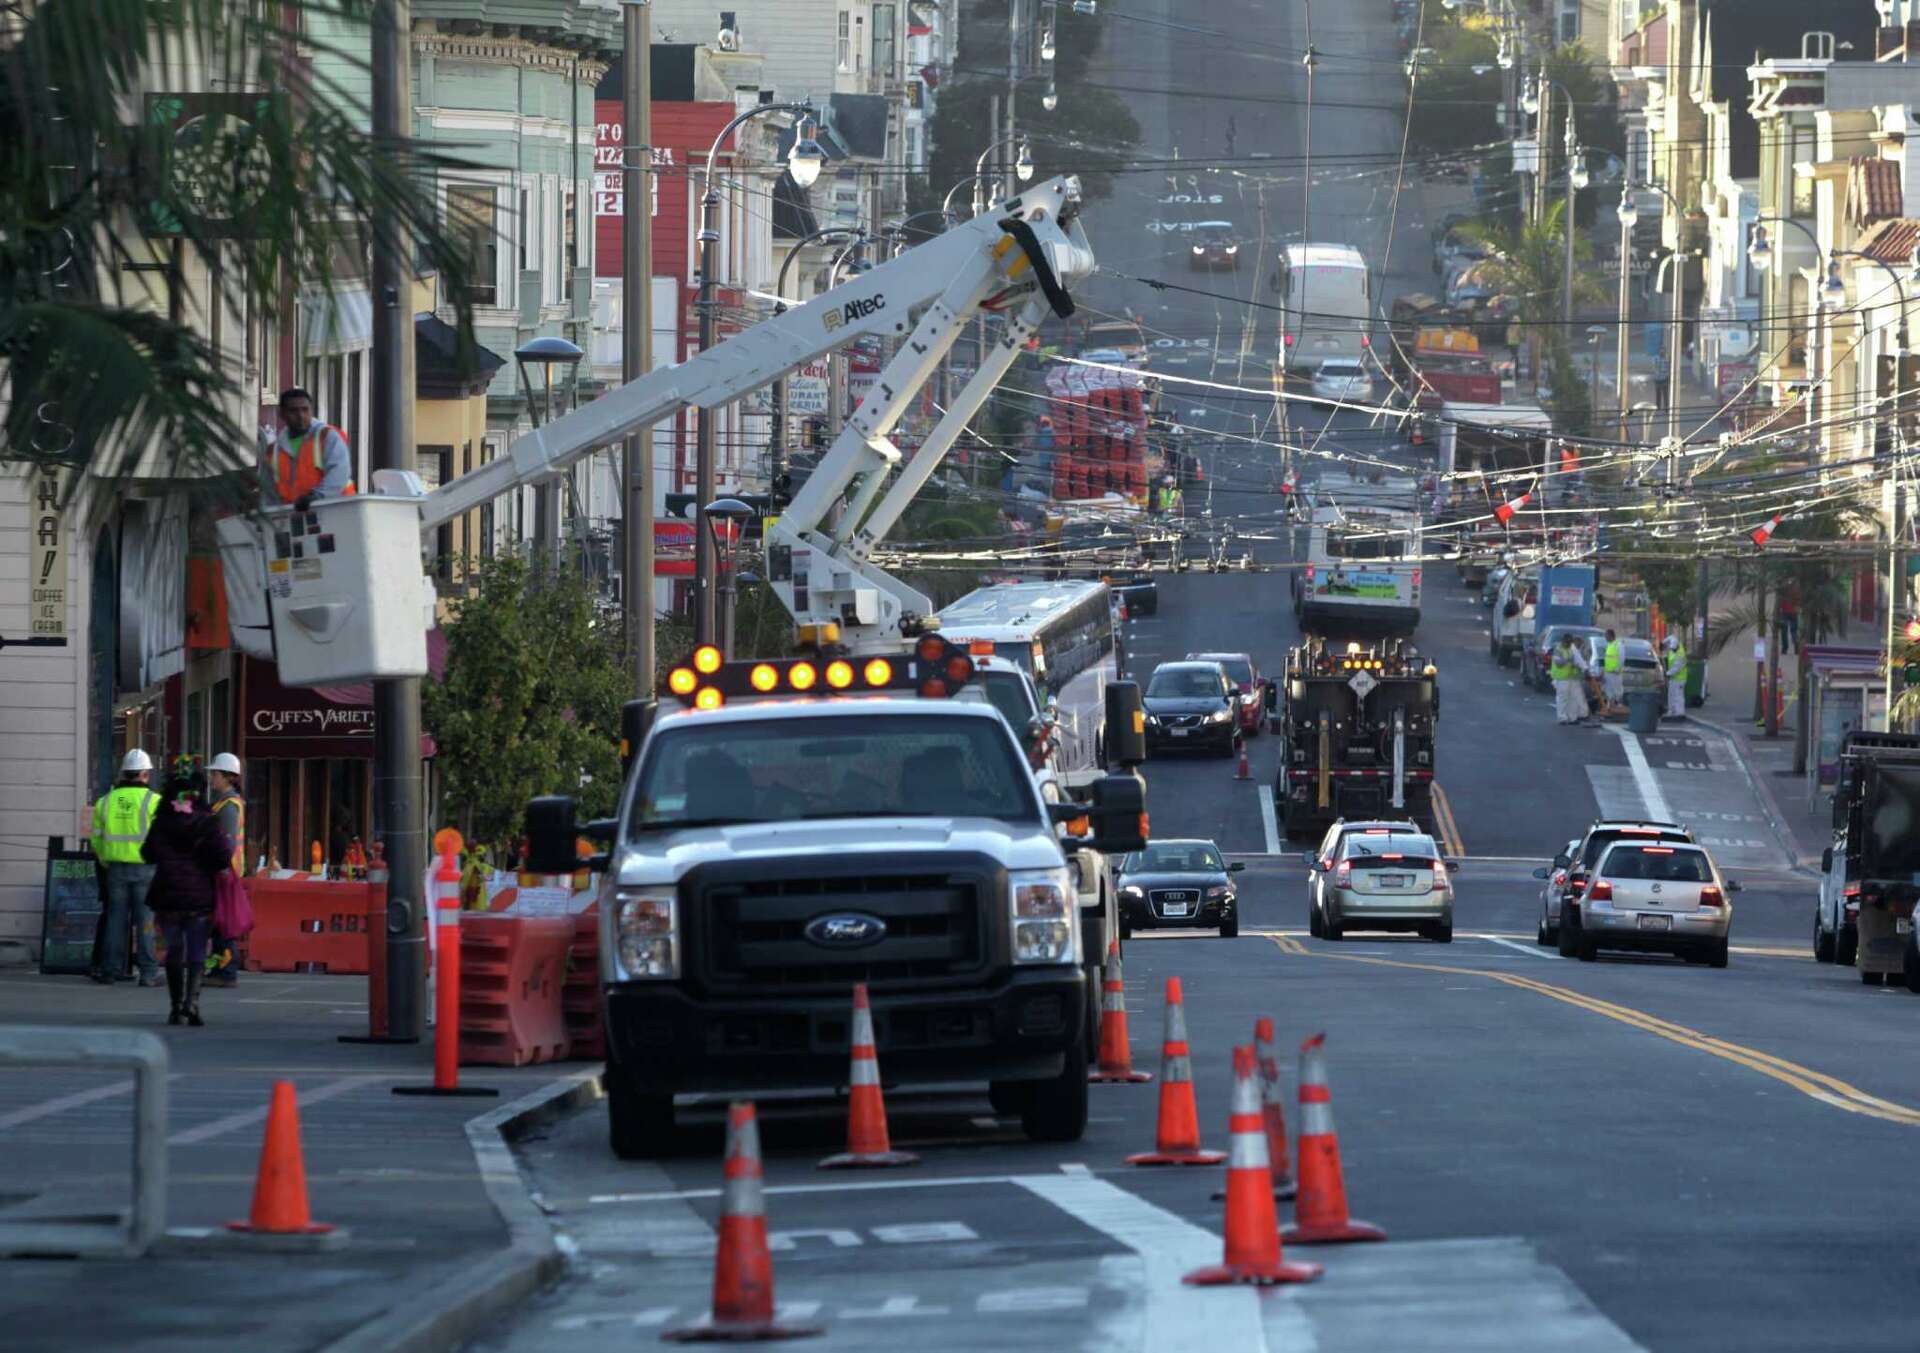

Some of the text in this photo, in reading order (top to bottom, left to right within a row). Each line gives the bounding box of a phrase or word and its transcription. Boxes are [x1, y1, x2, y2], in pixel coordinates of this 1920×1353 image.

[1603, 260, 1652, 271] BUALO
[844, 293, 886, 325] Altec
[33, 589, 64, 602] COFFEE
[40, 605, 55, 618] ICE
[32, 620, 63, 634] CREAM
